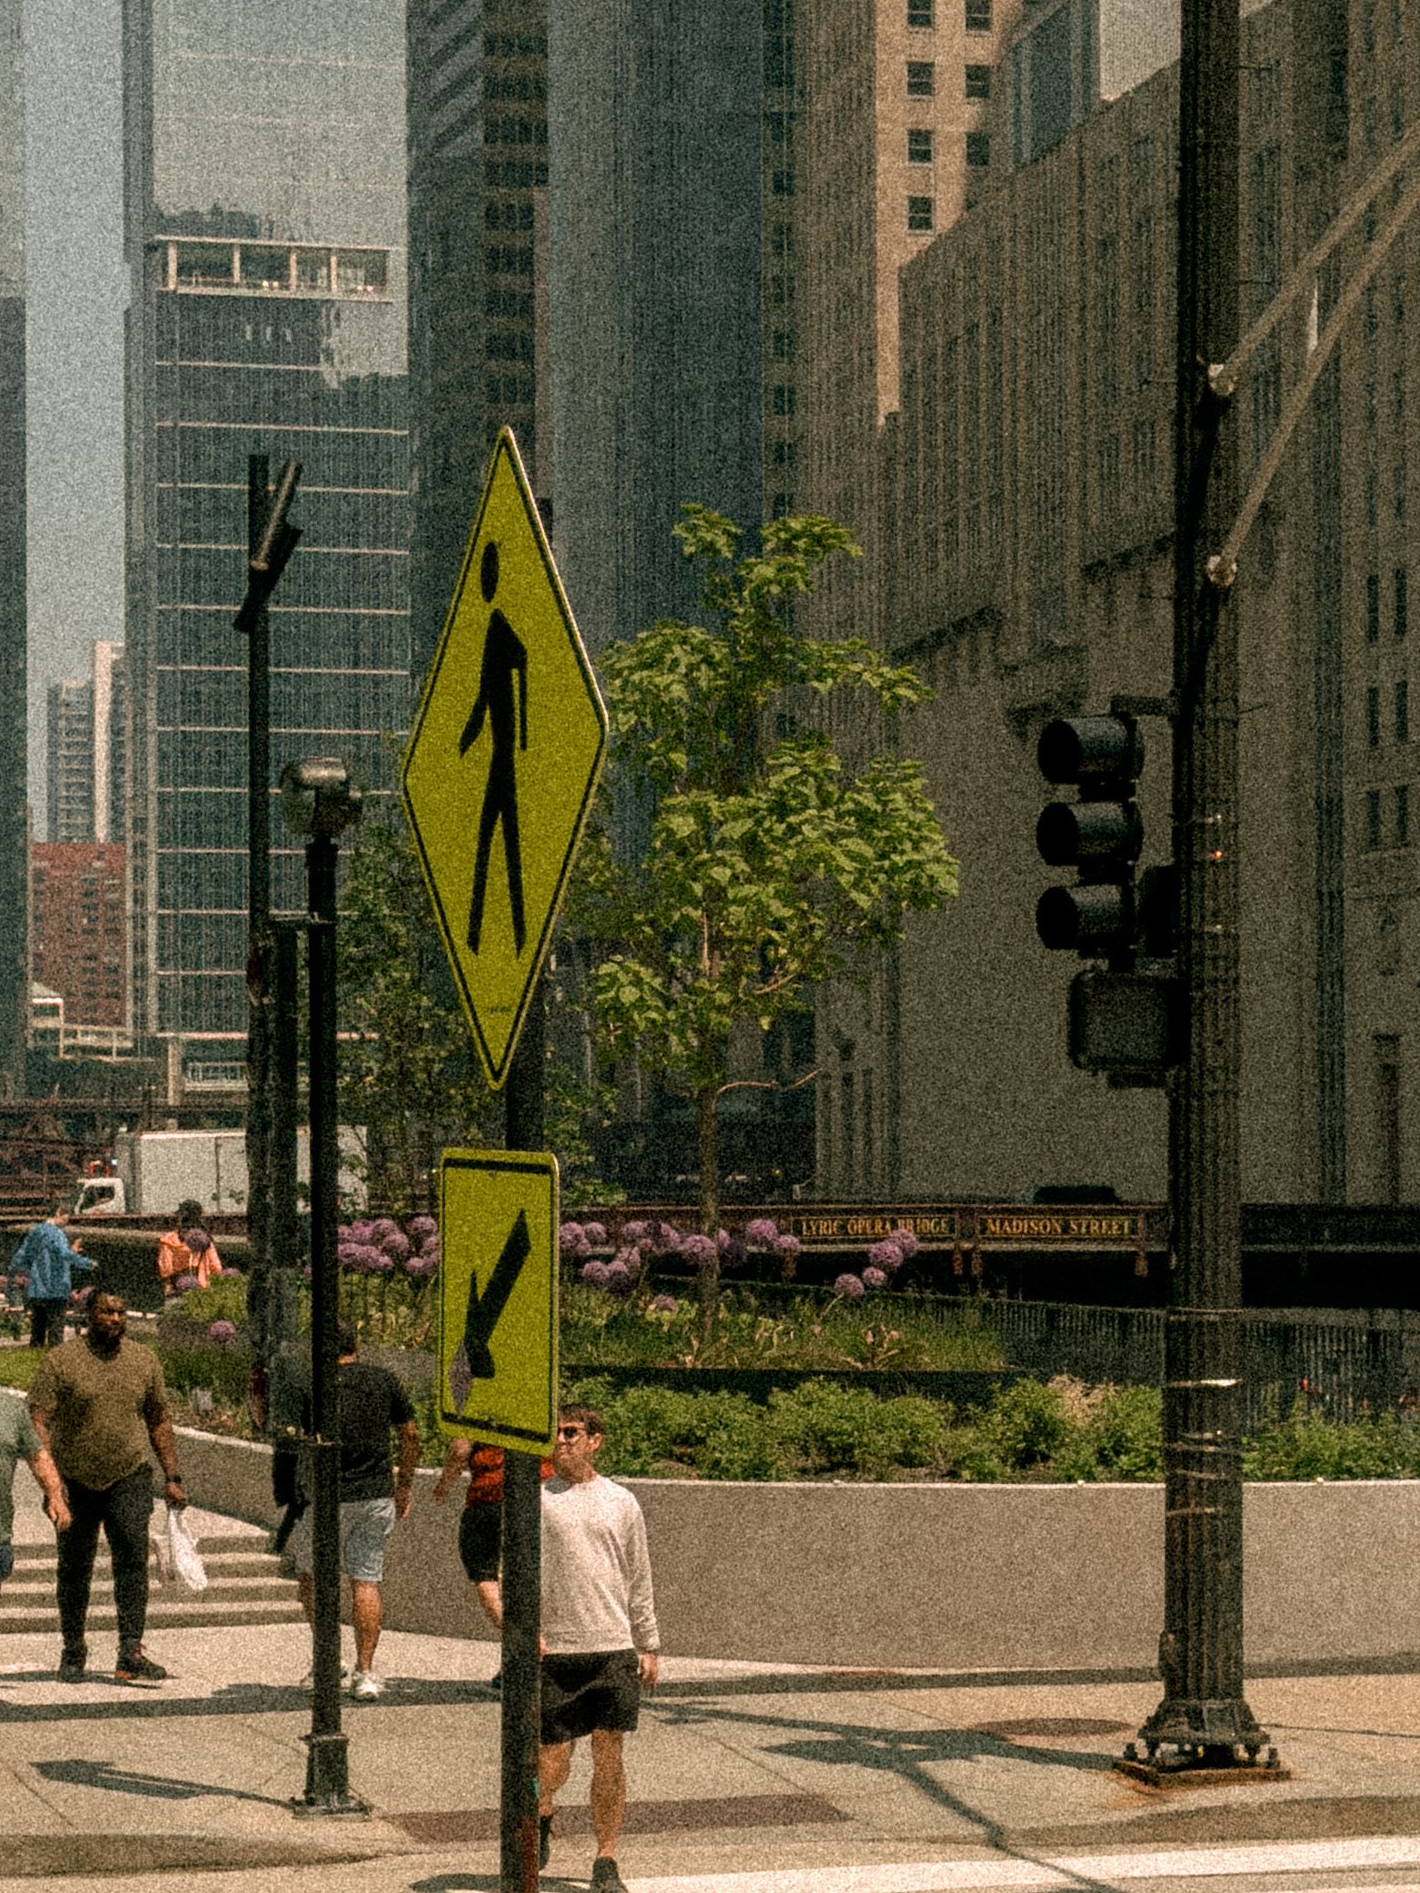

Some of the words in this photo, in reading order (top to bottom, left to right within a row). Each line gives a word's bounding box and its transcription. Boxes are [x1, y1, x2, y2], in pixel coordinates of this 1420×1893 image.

[801, 1218, 840, 1236] LYRIC
[847, 1218, 891, 1235] OPERA
[896, 1217, 949, 1235] BRIDGE
[986, 1217, 1063, 1235] MADISON
[1069, 1217, 1131, 1235] STREET
